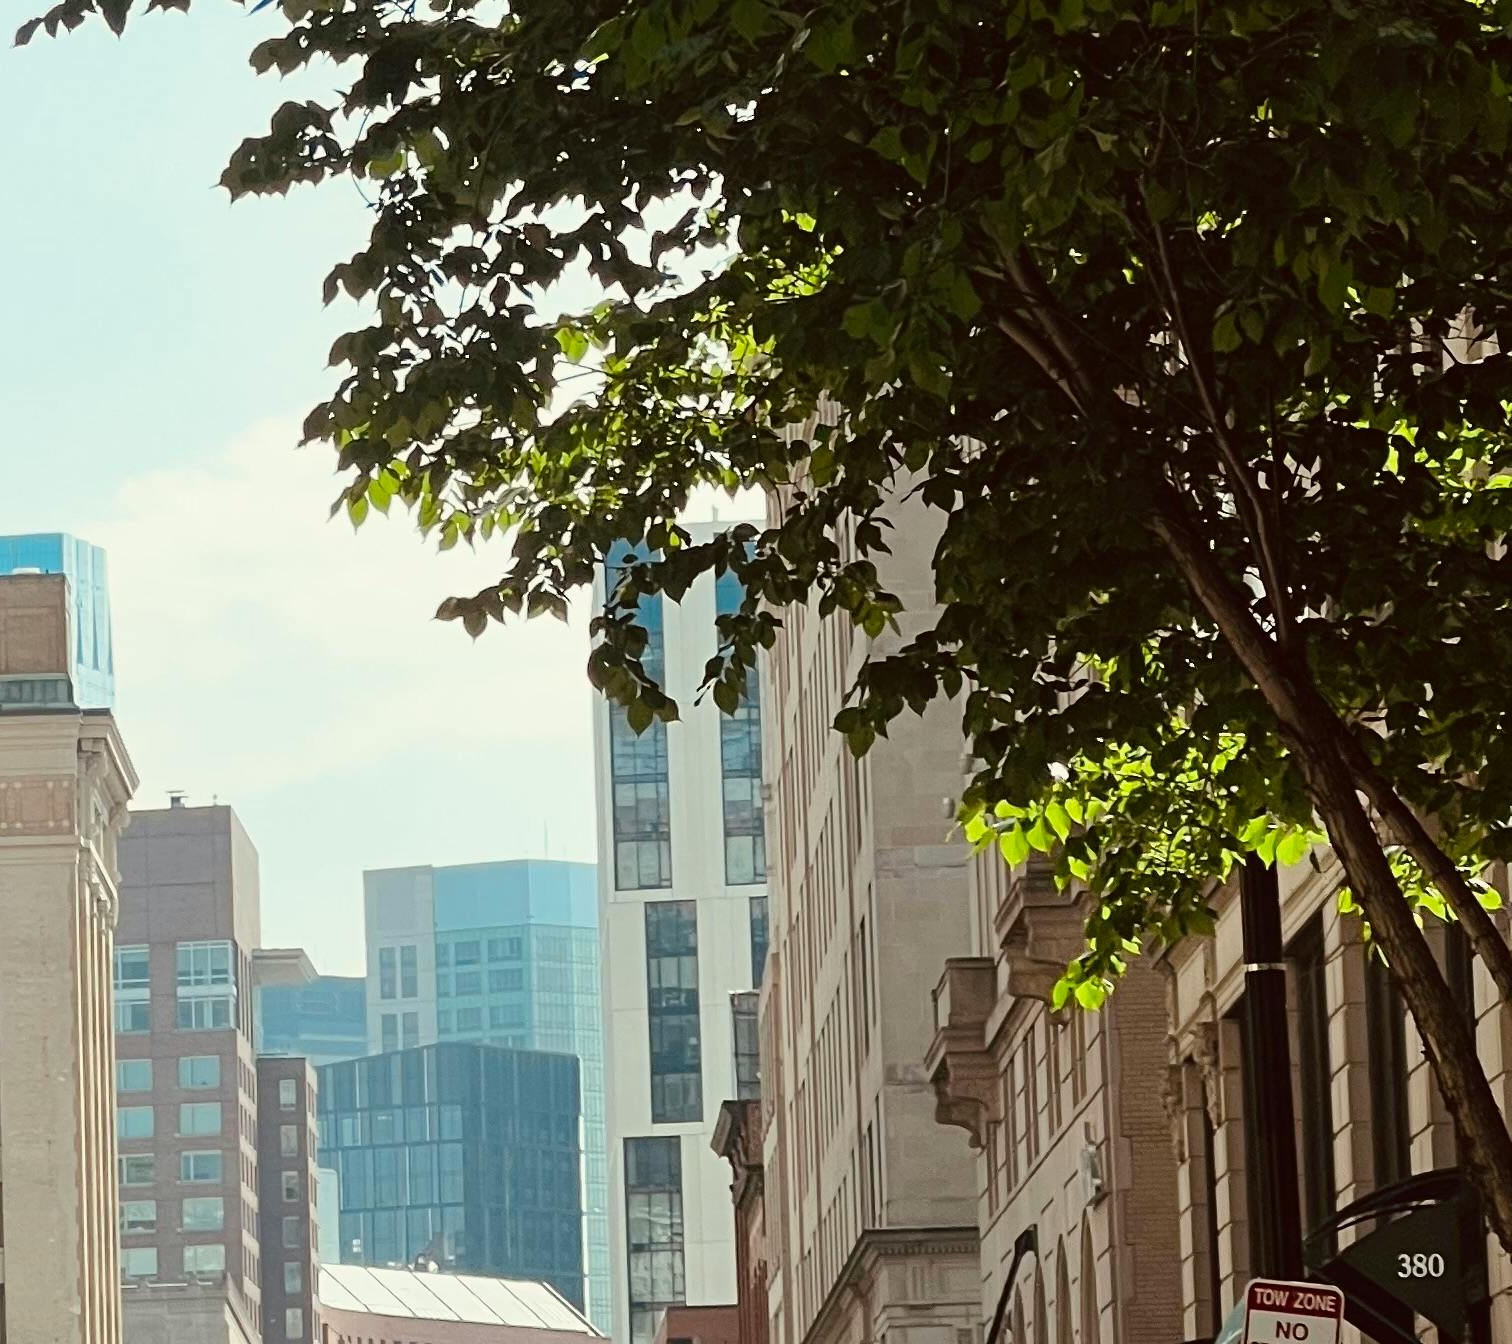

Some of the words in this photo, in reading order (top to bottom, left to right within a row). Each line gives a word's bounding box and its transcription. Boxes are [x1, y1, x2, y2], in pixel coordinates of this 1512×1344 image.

[1397, 1253, 1445, 1278] 380
[1254, 1288, 1289, 1307] TOW
[1293, 1292, 1337, 1312] ZONE
[1275, 1320, 1309, 1341] NO
